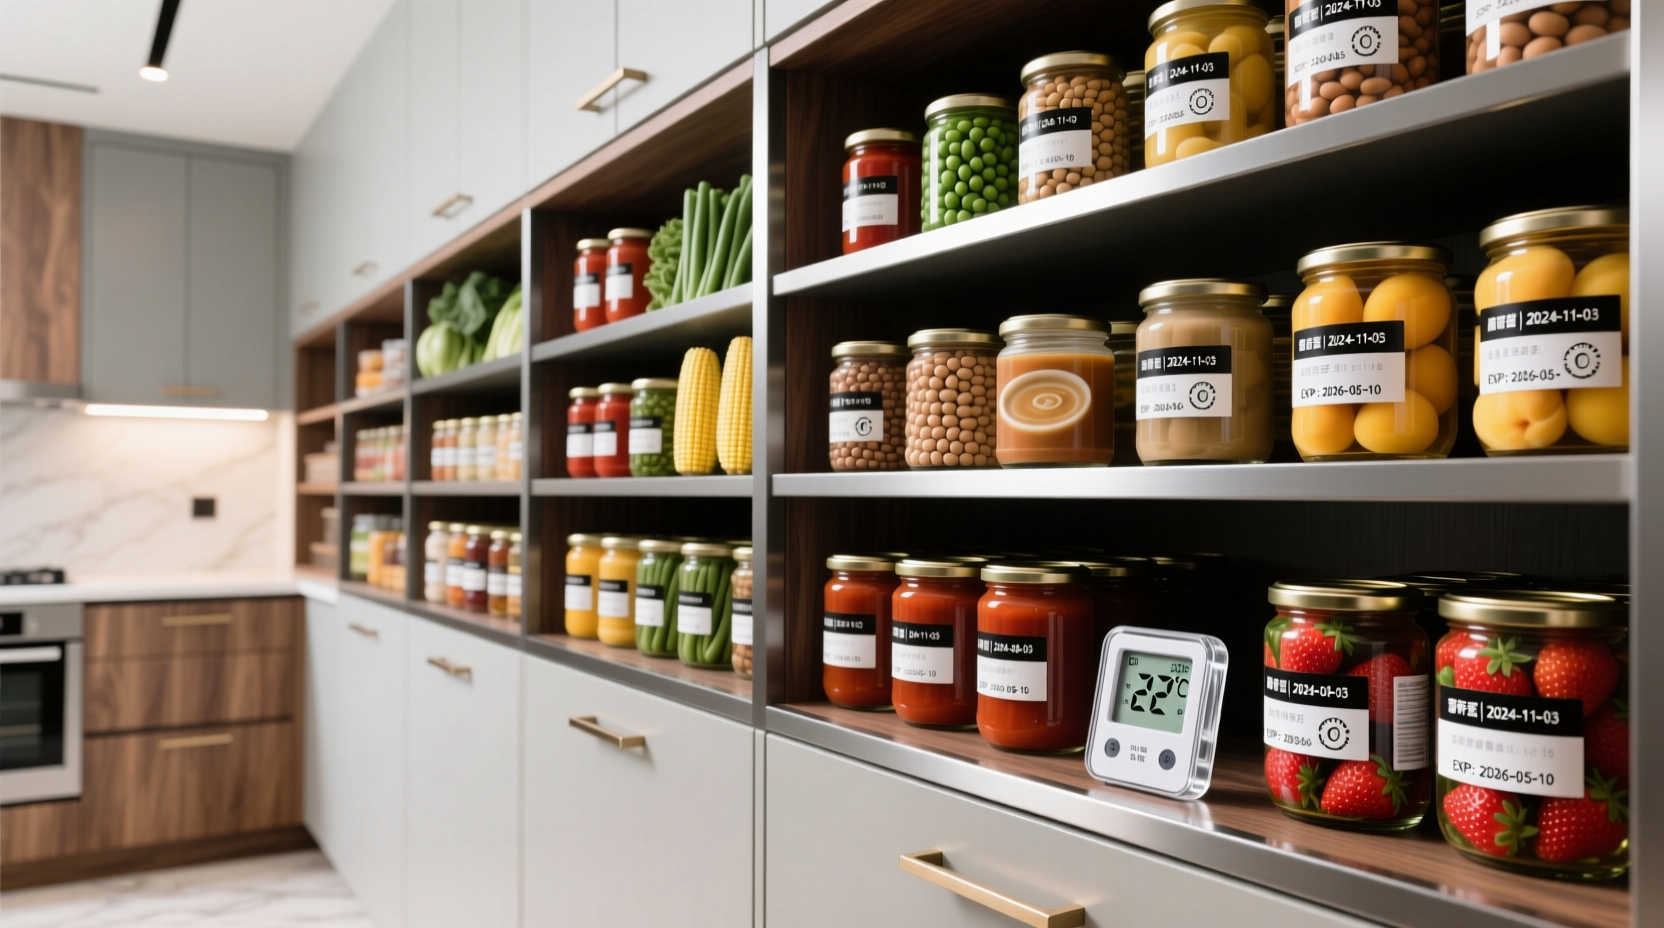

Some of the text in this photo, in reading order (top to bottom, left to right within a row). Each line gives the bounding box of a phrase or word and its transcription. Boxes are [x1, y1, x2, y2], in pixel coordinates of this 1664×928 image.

[1526, 308, 1599, 326] 2024-11-03
[1486, 705, 1560, 725] 2024-11-03
[1479, 765, 1555, 786] 2026-05-10
